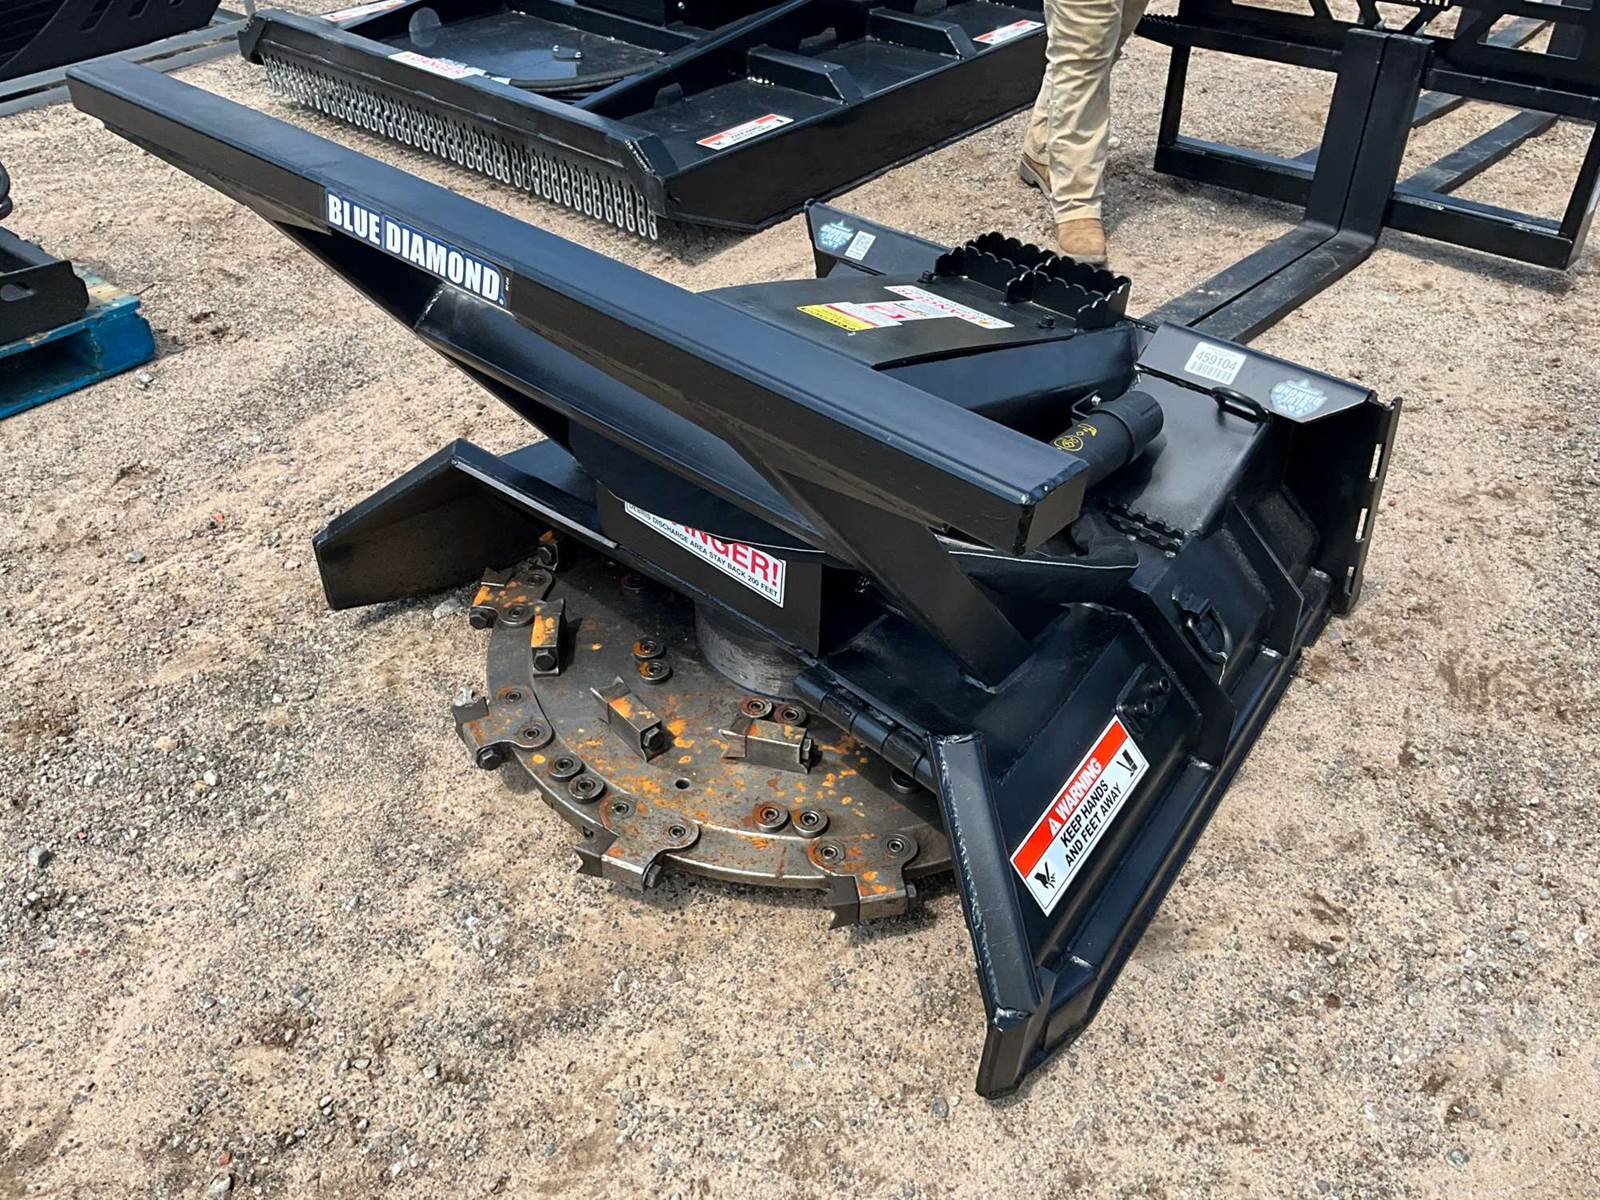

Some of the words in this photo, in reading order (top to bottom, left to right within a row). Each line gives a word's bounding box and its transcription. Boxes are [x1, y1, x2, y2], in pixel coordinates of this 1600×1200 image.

[328, 193, 381, 245] BLUE
[385, 220, 500, 302] DIAMOND
[1195, 351, 1237, 370] 459104
[652, 517, 689, 543] DISCHARGE
[690, 540, 708, 556] AREA
[709, 551, 726, 566] STAY
[727, 562, 746, 579] BACK
[747, 575, 760, 587] 200
[761, 582, 779, 598] FEET
[1055, 757, 1103, 818] WARNING
[1060, 814, 1082, 848] KEEP
[1080, 779, 1109, 819] HANDS
[1065, 839, 1083, 867] AND
[1080, 811, 1102, 843] FEET
[1099, 782, 1122, 817] AWAY
